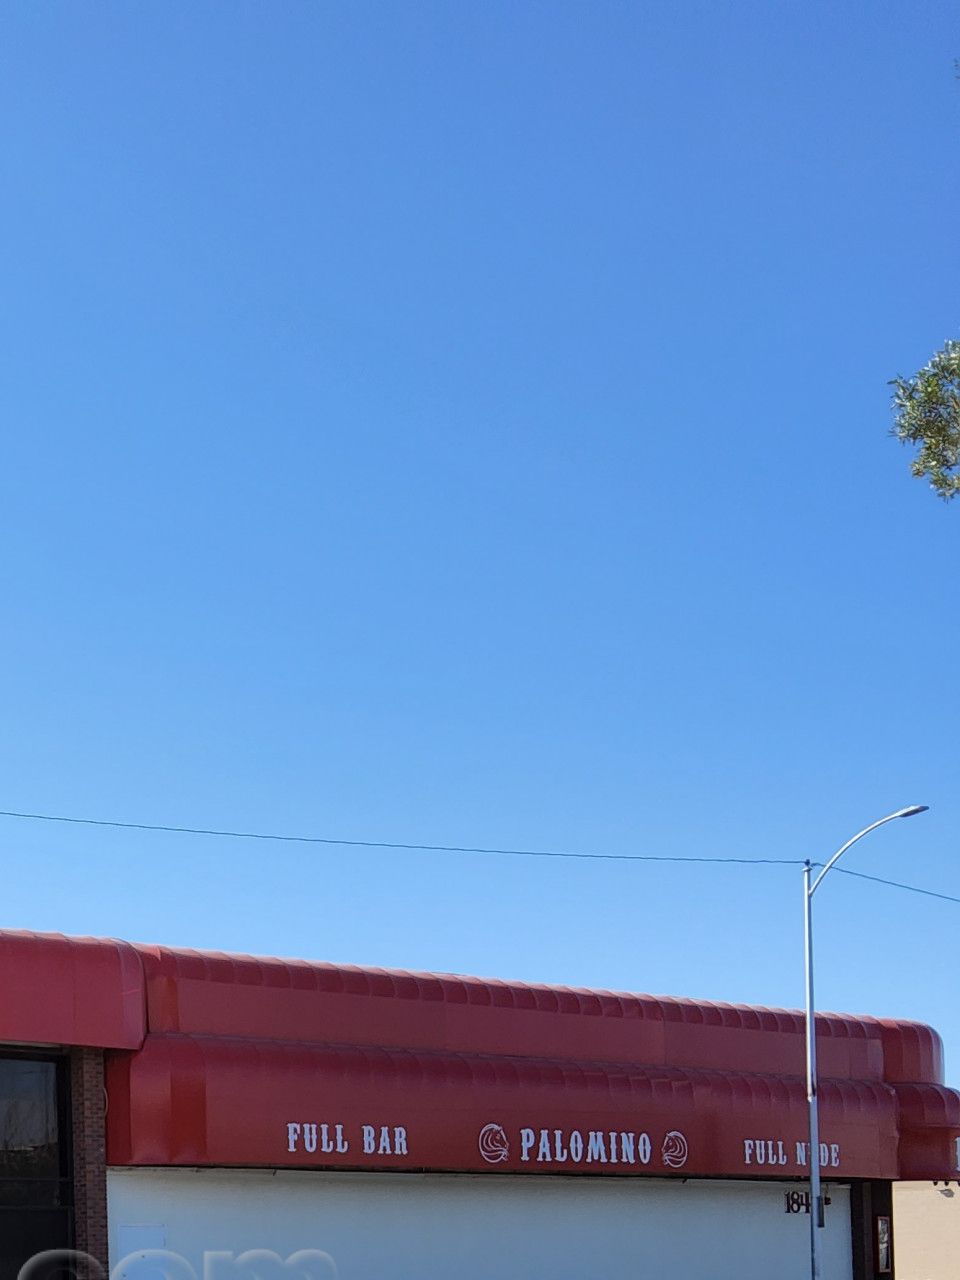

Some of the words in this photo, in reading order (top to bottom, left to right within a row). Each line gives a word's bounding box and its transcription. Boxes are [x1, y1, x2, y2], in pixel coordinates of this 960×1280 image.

[287, 1122, 348, 1153] FULL
[361, 1125, 408, 1155] BAR
[520, 1128, 652, 1163] PALOMINO
[744, 1139, 787, 1165] FULL
[796, 1141, 840, 1167] NDE
